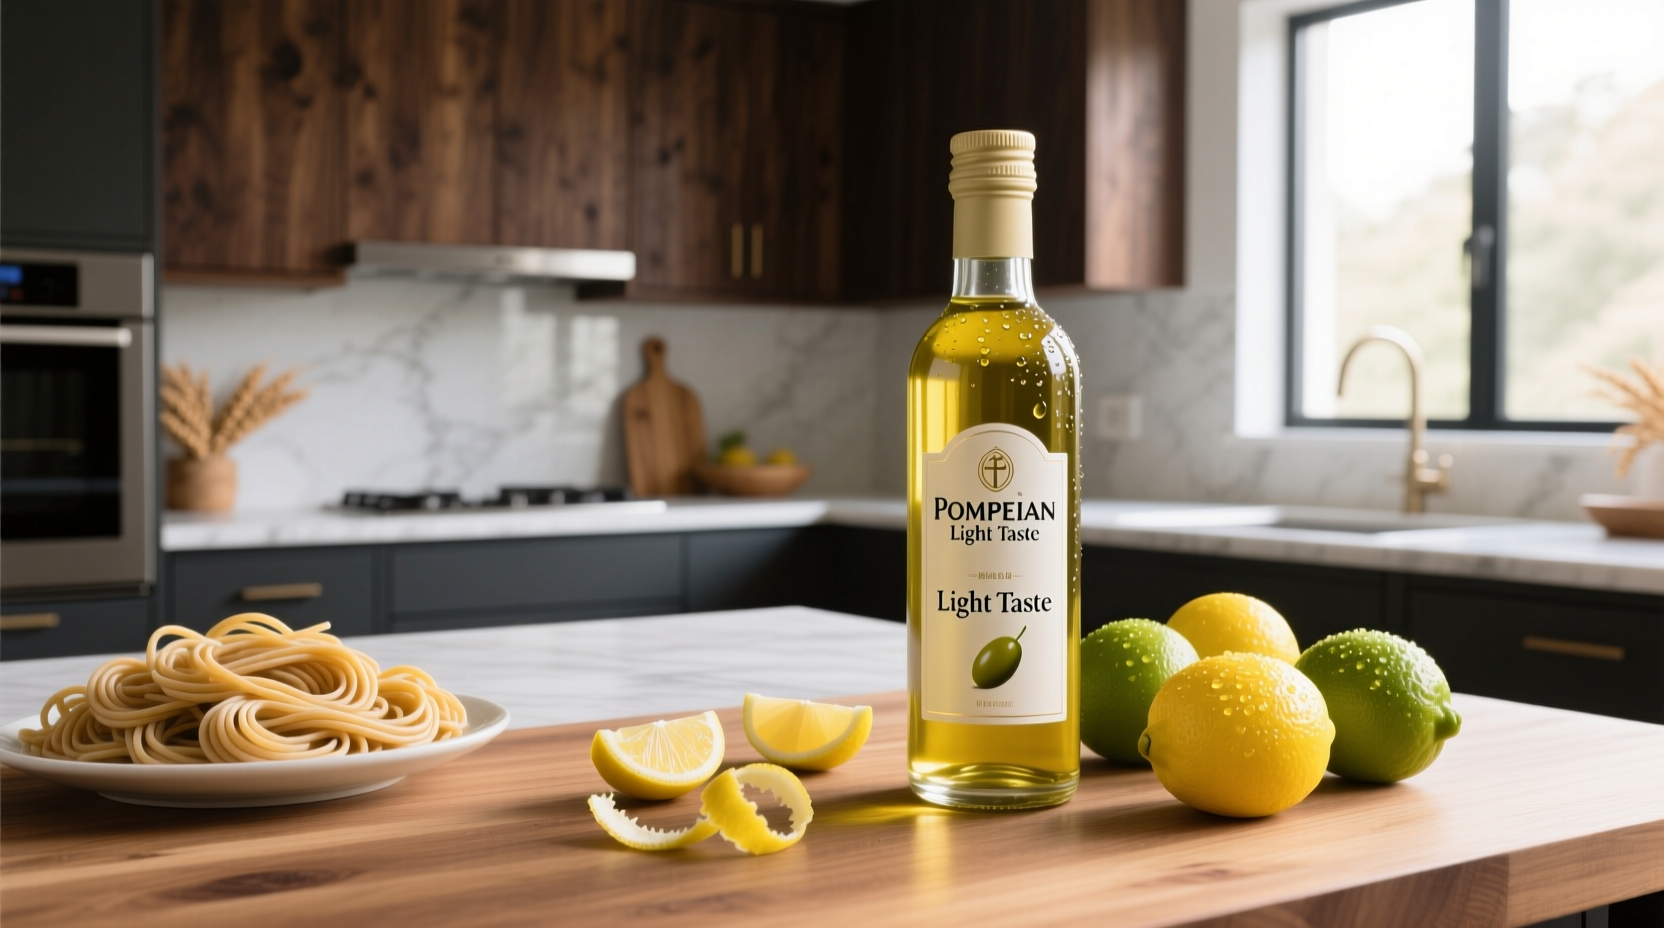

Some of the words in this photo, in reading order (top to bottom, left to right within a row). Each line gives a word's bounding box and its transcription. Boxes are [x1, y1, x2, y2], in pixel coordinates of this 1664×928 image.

[950, 525, 992, 545] Light
[998, 525, 1040, 541] Taste
[937, 590, 992, 618] Light
[996, 591, 1052, 613] Taste
